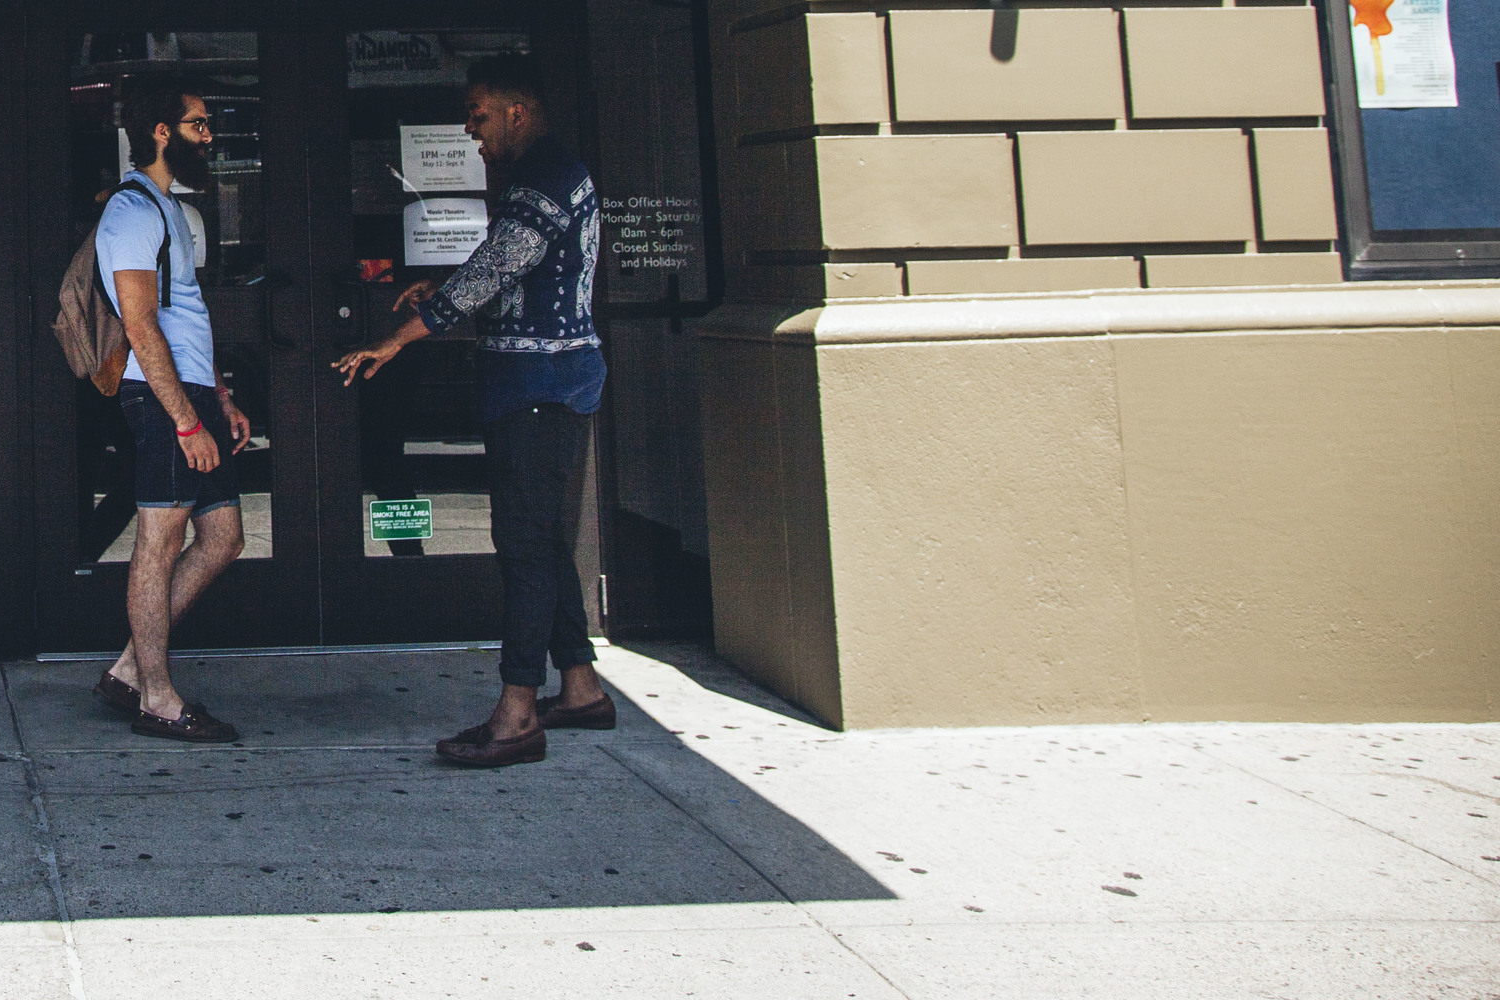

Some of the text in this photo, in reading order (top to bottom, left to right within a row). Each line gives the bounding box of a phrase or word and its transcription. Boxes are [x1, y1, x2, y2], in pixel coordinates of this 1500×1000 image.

[421, 151, 438, 159] 1PM
[447, 150, 466, 158] 6PM
[602, 196, 699, 208] Box Office Hours
[600, 212, 641, 226] Monday
[656, 211, 701, 224] Saturday
[621, 227, 647, 238] 10am
[660, 227, 684, 239] 6pm
[612, 241, 694, 254] Closed Sundays
[621, 257, 687, 270] and Holidays
